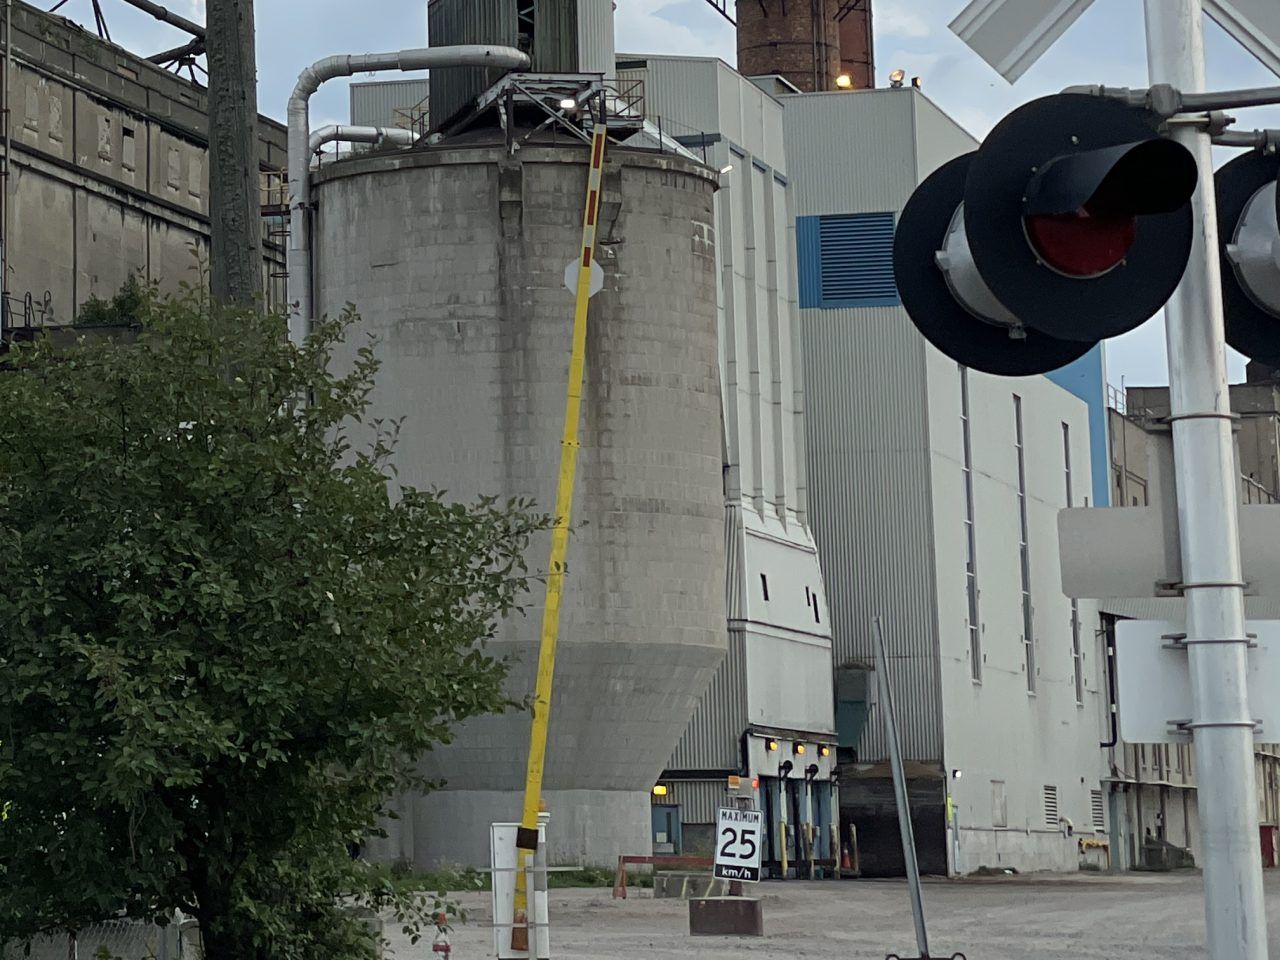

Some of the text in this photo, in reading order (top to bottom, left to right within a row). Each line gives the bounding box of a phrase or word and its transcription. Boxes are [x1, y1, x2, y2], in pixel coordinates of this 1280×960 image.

[722, 811, 759, 823] MAXIMUM
[720, 827, 756, 859] 25
[722, 867, 751, 878] km/h
